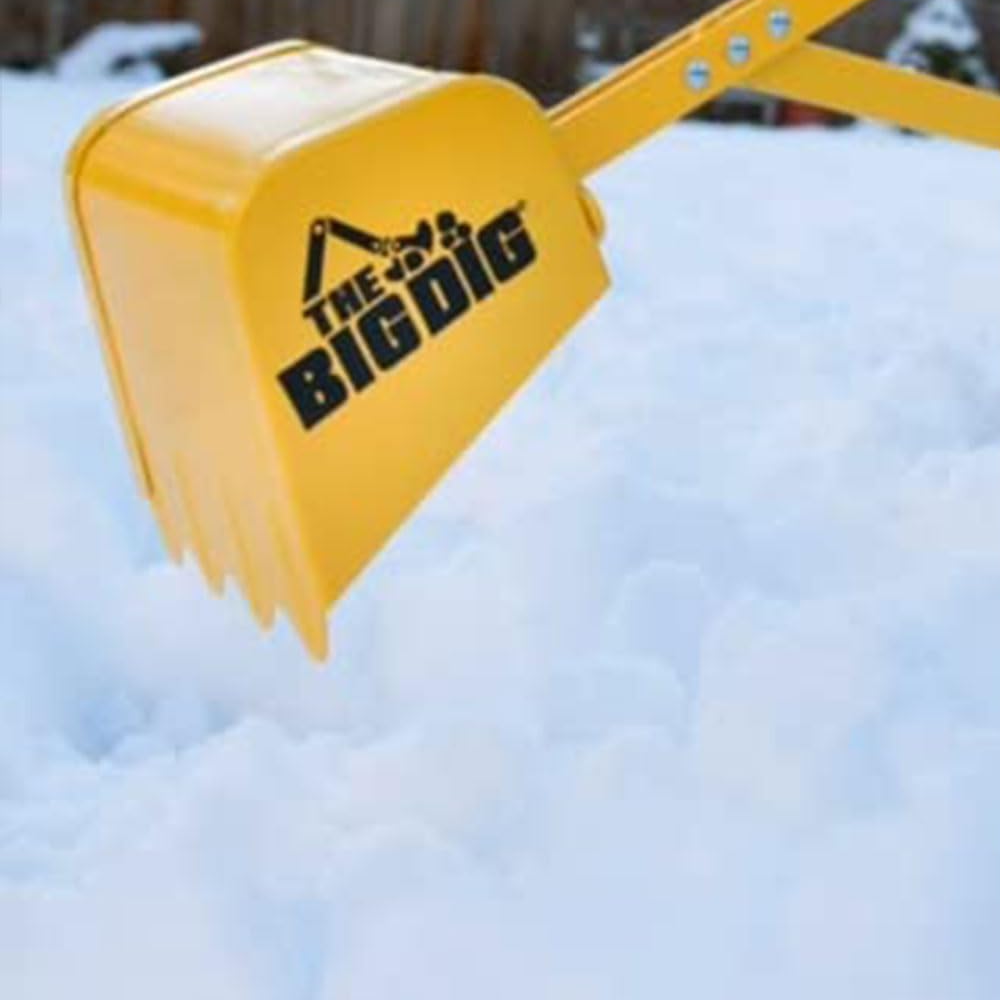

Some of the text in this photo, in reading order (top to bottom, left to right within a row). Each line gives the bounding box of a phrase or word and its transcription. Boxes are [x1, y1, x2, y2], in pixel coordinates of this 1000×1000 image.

[277, 209, 537, 430] BIG DIG
[303, 264, 385, 338] THE
